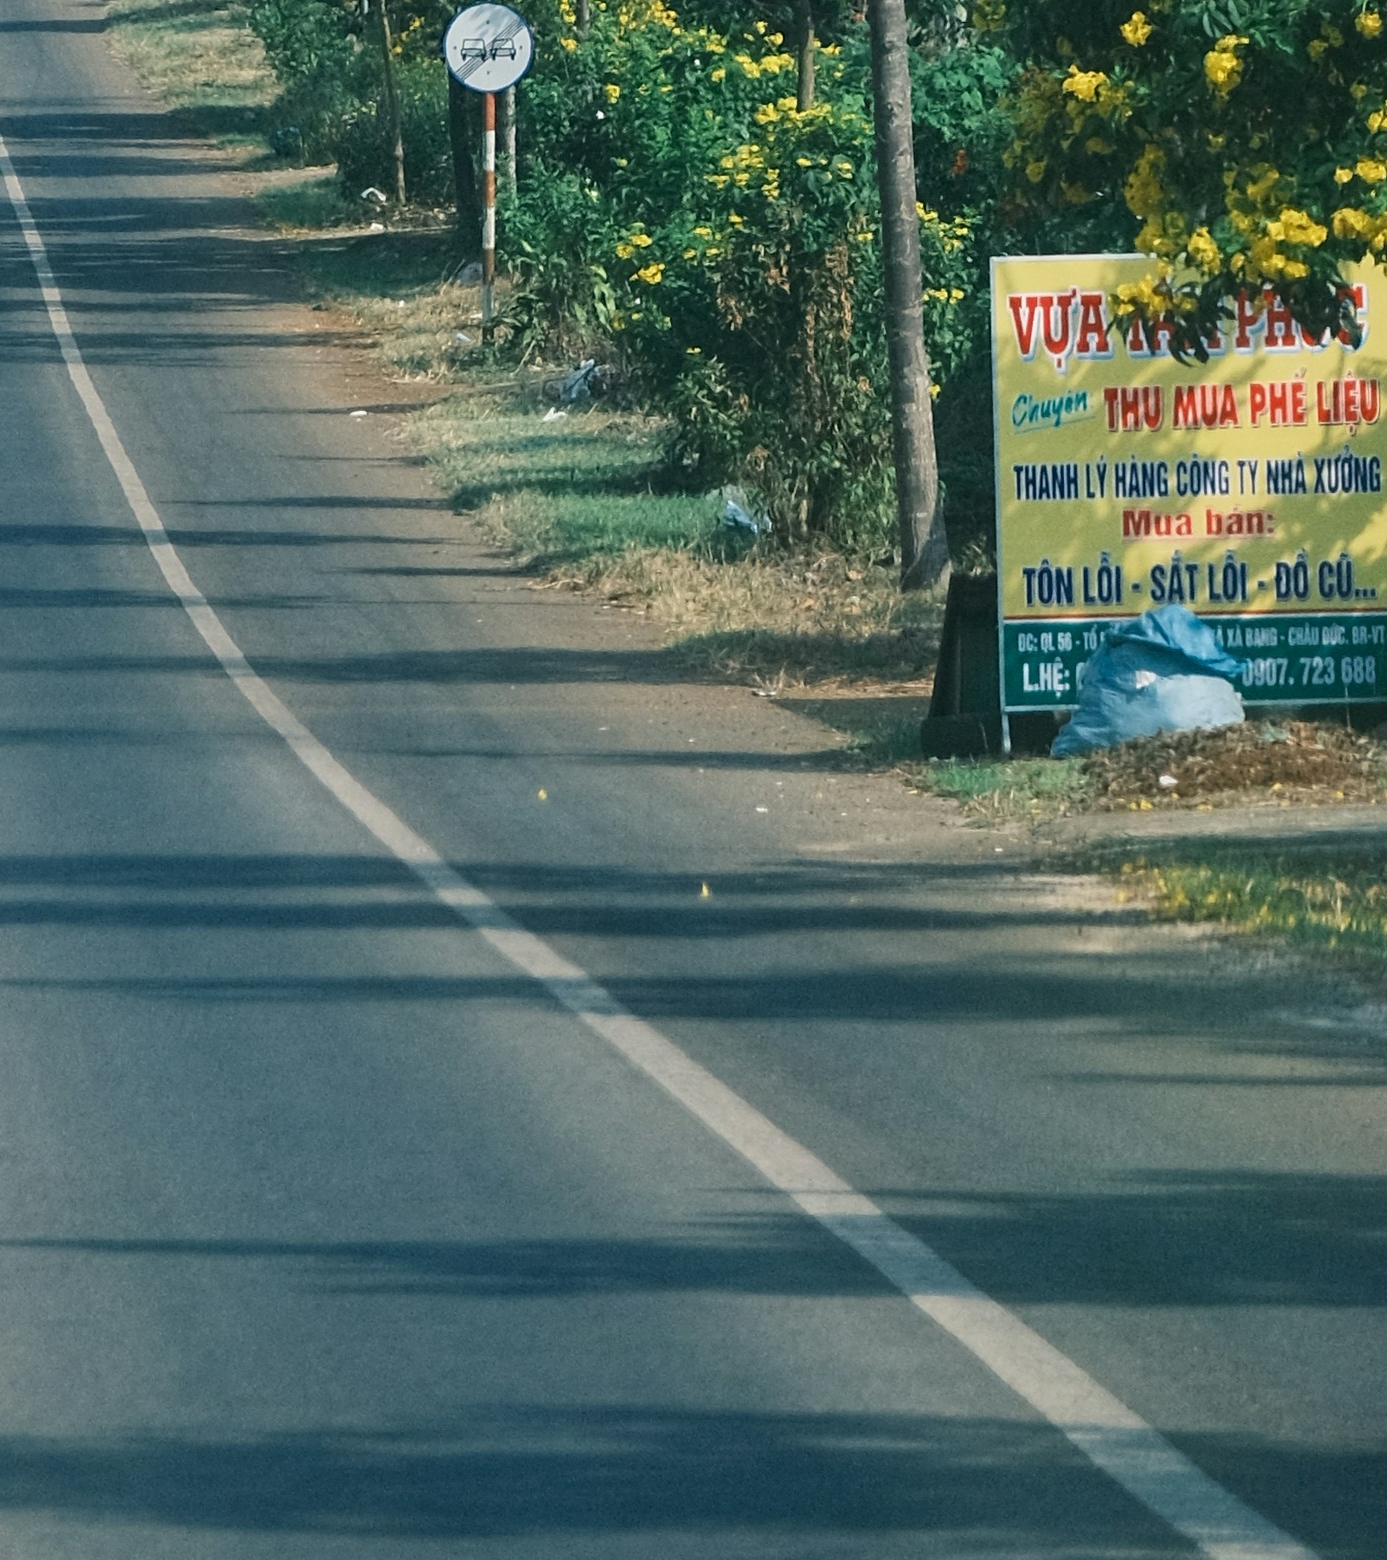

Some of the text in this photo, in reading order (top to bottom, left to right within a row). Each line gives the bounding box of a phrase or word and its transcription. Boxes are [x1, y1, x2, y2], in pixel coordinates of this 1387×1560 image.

[1009, 287, 1110, 370] VỰA
[1103, 386, 1162, 430] THU
[1173, 384, 1239, 427] MUA
[1249, 367, 1307, 425] PHẾ
[1317, 370, 1379, 434] LIỆU
[1013, 444, 1381, 500] THANH LÝ HÀNG CÔNG TY NHÀ XƯỞNG
[1122, 505, 1275, 536] Mua bán:
[1023, 558, 1073, 604] TÔN
[1258, 581, 1267, 589] -
[1274, 547, 1309, 599] ĐỒ
[1299, 657, 1335, 685] 723
[1341, 655, 1376, 684] 688
